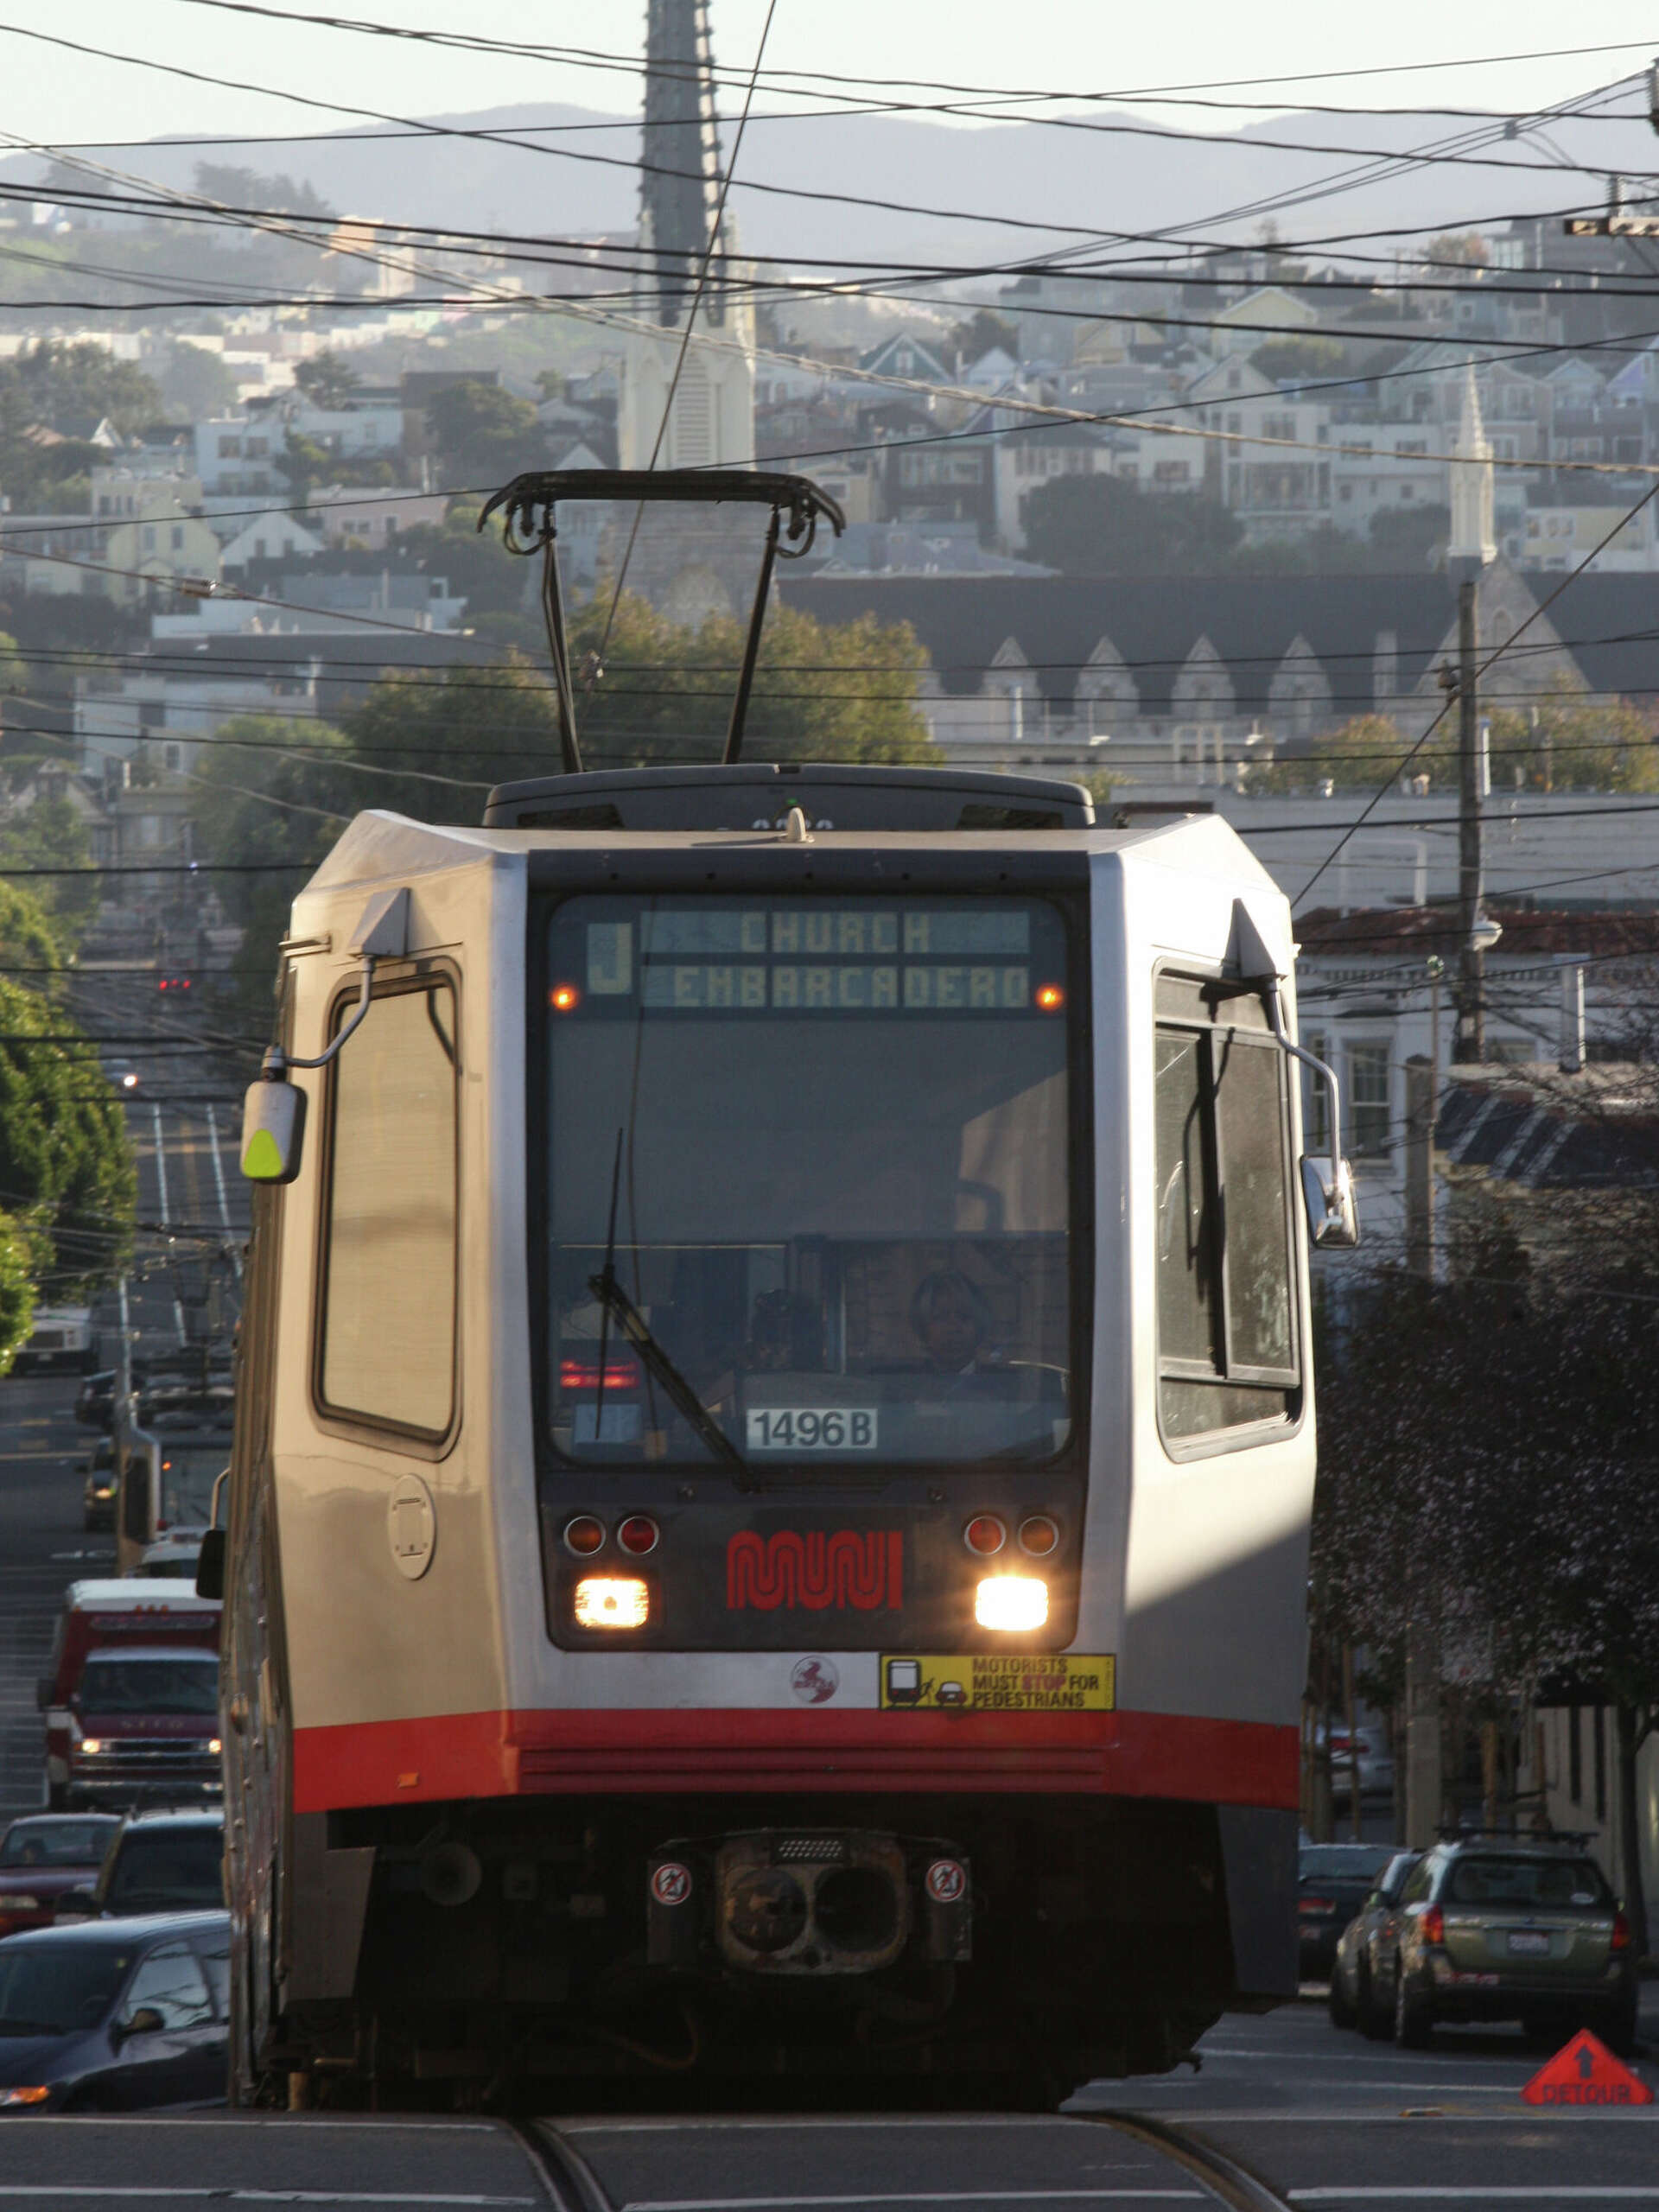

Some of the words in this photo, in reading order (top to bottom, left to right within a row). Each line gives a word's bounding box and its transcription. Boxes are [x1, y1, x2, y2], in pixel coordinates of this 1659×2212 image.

[739, 912, 931, 951] CHURCH
[588, 923, 632, 994] J
[673, 965, 1029, 1007] EMBARCADERO
[726, 1529, 903, 1611] MUNI
[972, 1657, 1068, 1674] MOTORISTS
[972, 1675, 1020, 1690] MUST
[1021, 1674, 1066, 1690] STOP
[1069, 1675, 1100, 1690] FOR
[972, 1691, 1085, 1707] PEDESTRIANS
[1542, 2083, 1631, 2105] DETOUR
